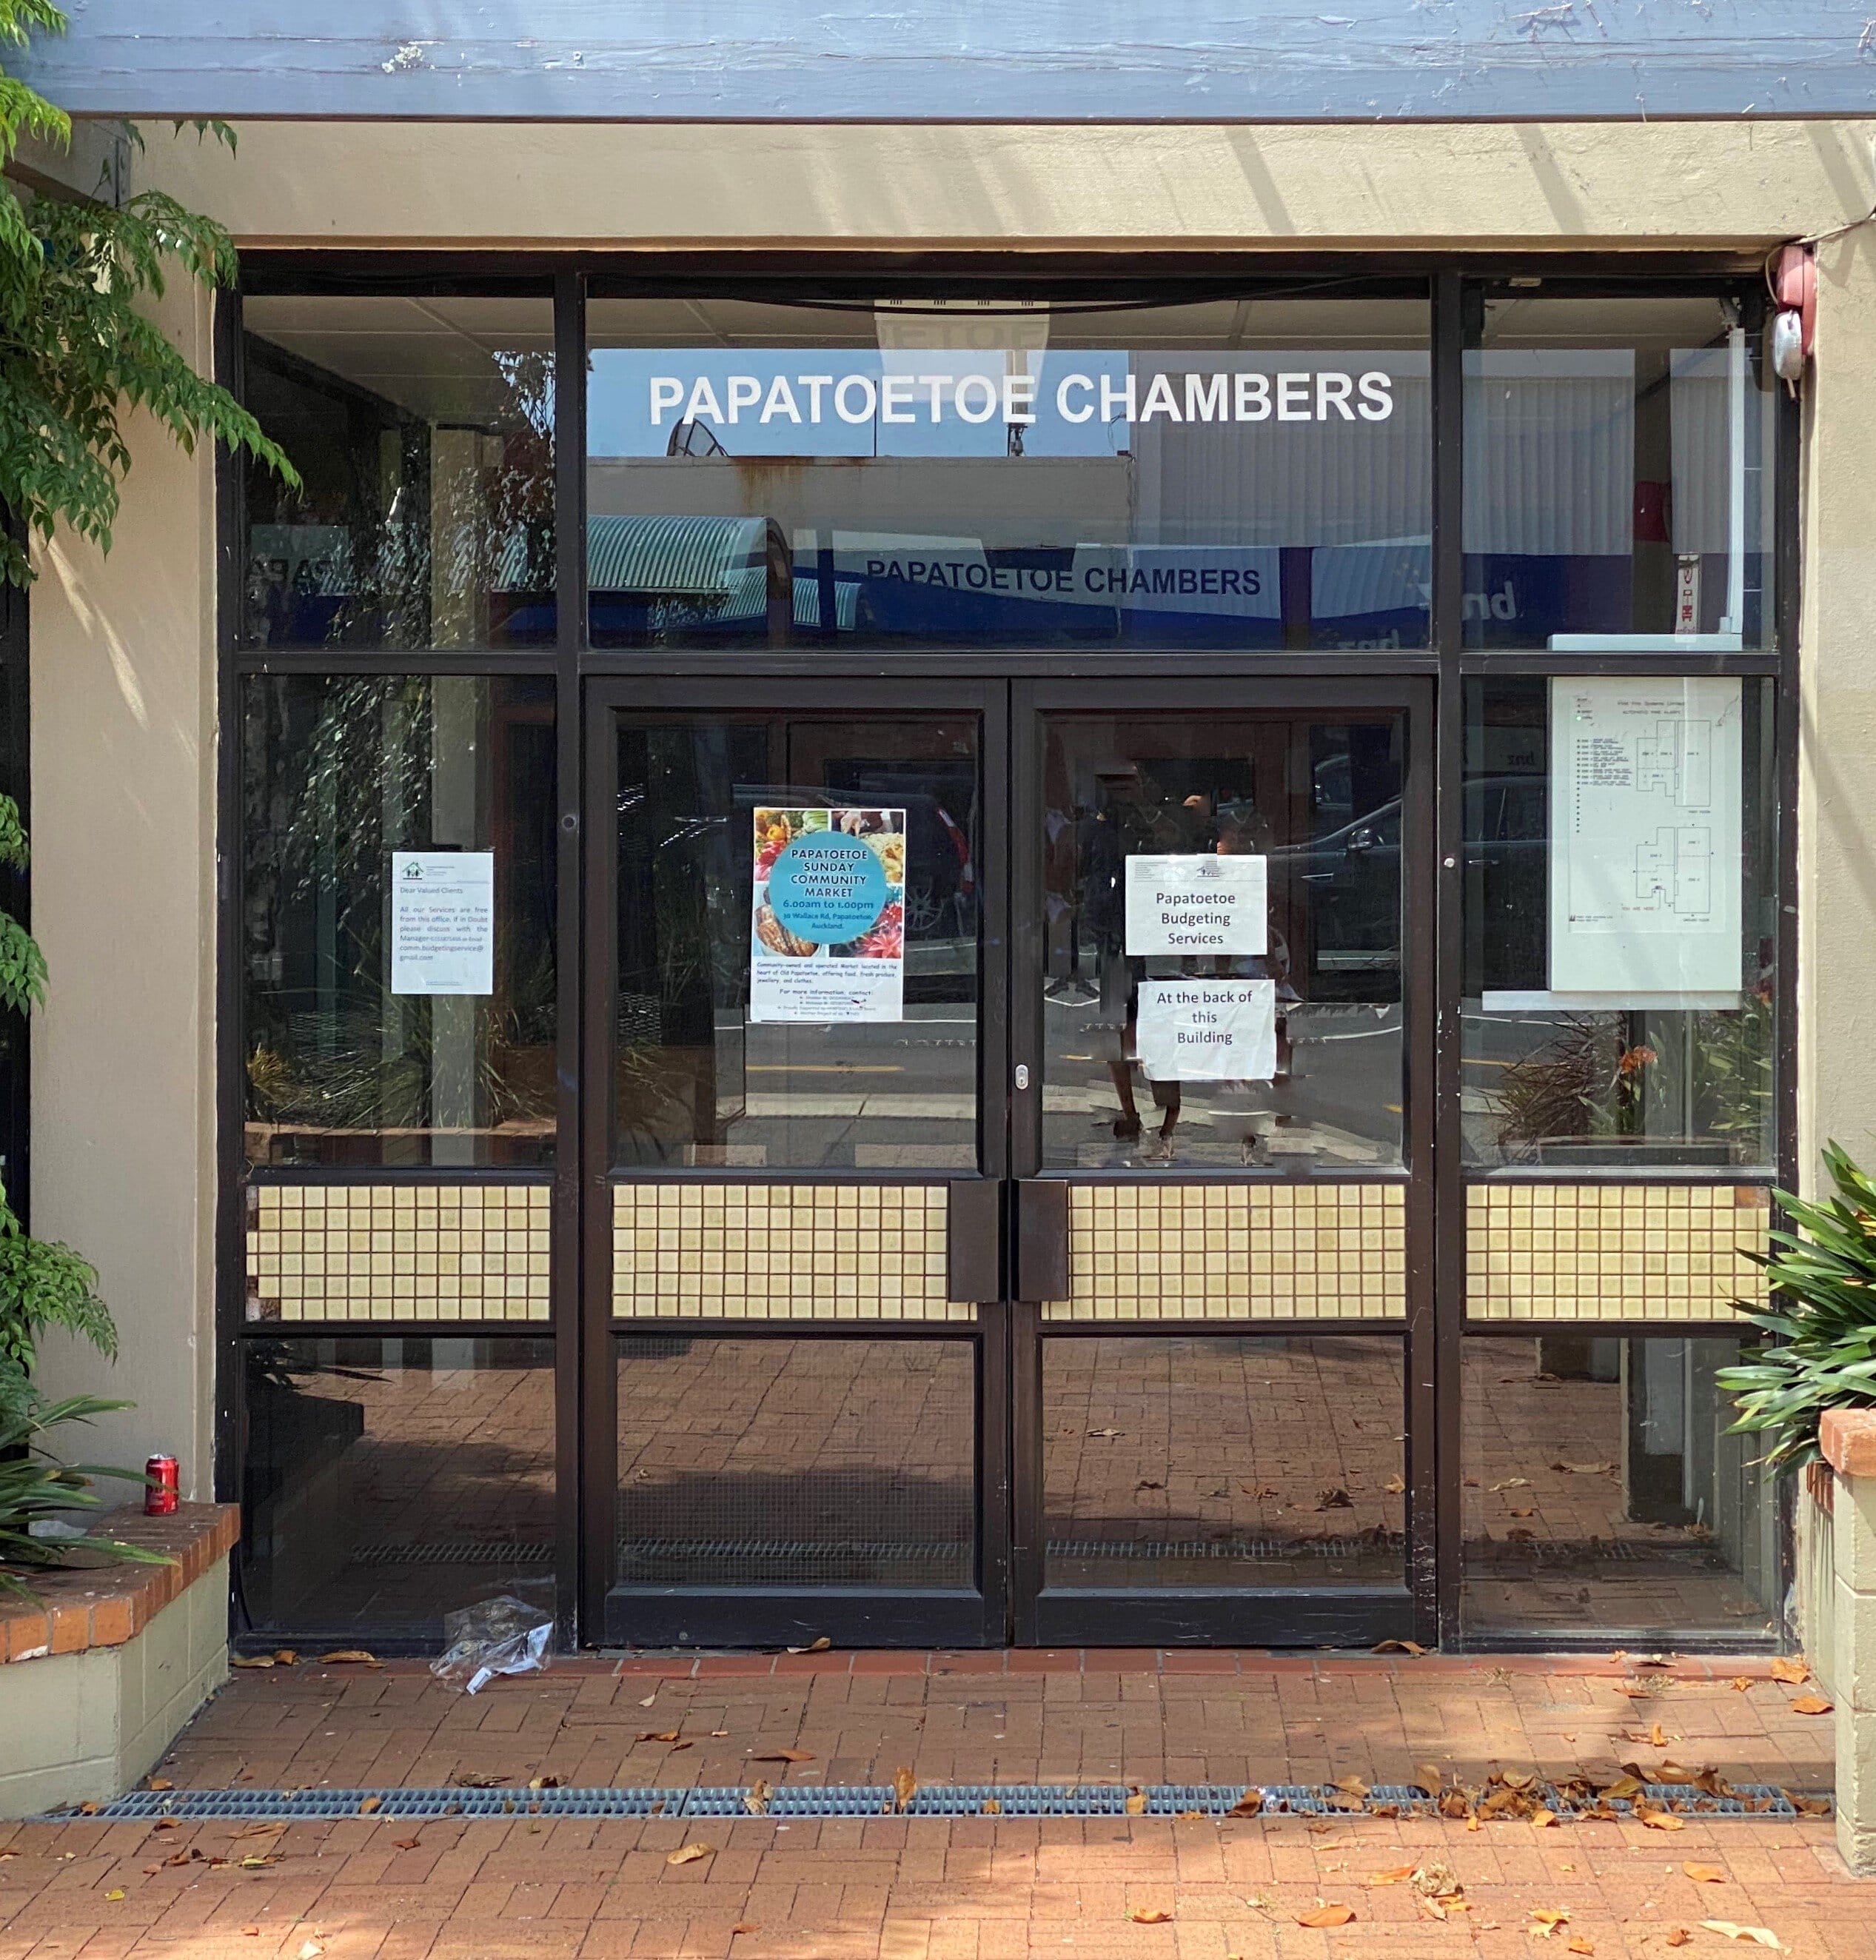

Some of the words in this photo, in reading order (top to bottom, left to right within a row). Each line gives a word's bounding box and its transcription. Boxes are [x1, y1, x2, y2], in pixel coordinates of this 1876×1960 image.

[650, 374, 1035, 426] PAPATOETOE
[1056, 371, 1393, 424] CHAMBERS
[867, 561, 1073, 592] PAPATOETOE
[1085, 568, 1261, 595] CHAMBERS
[791, 849, 868, 860] PAPATOETOE
[803, 862, 854, 872] SUNDAY
[791, 874, 866, 885] COMMUNITY
[804, 887, 853, 897] MARKET
[783, 899, 820, 908] 6.00am
[824, 900, 834, 909] to
[1156, 892, 1236, 906] Papatoetoe
[1162, 912, 1230, 926] Budgeting
[1168, 932, 1224, 945] Services
[1156, 992, 1173, 1004] At
[1176, 991, 1199, 1004] the
[1203, 991, 1234, 1003] back
[1239, 990, 1253, 1003] of
[1192, 1011, 1217, 1023] this
[1178, 1031, 1233, 1046] Building
